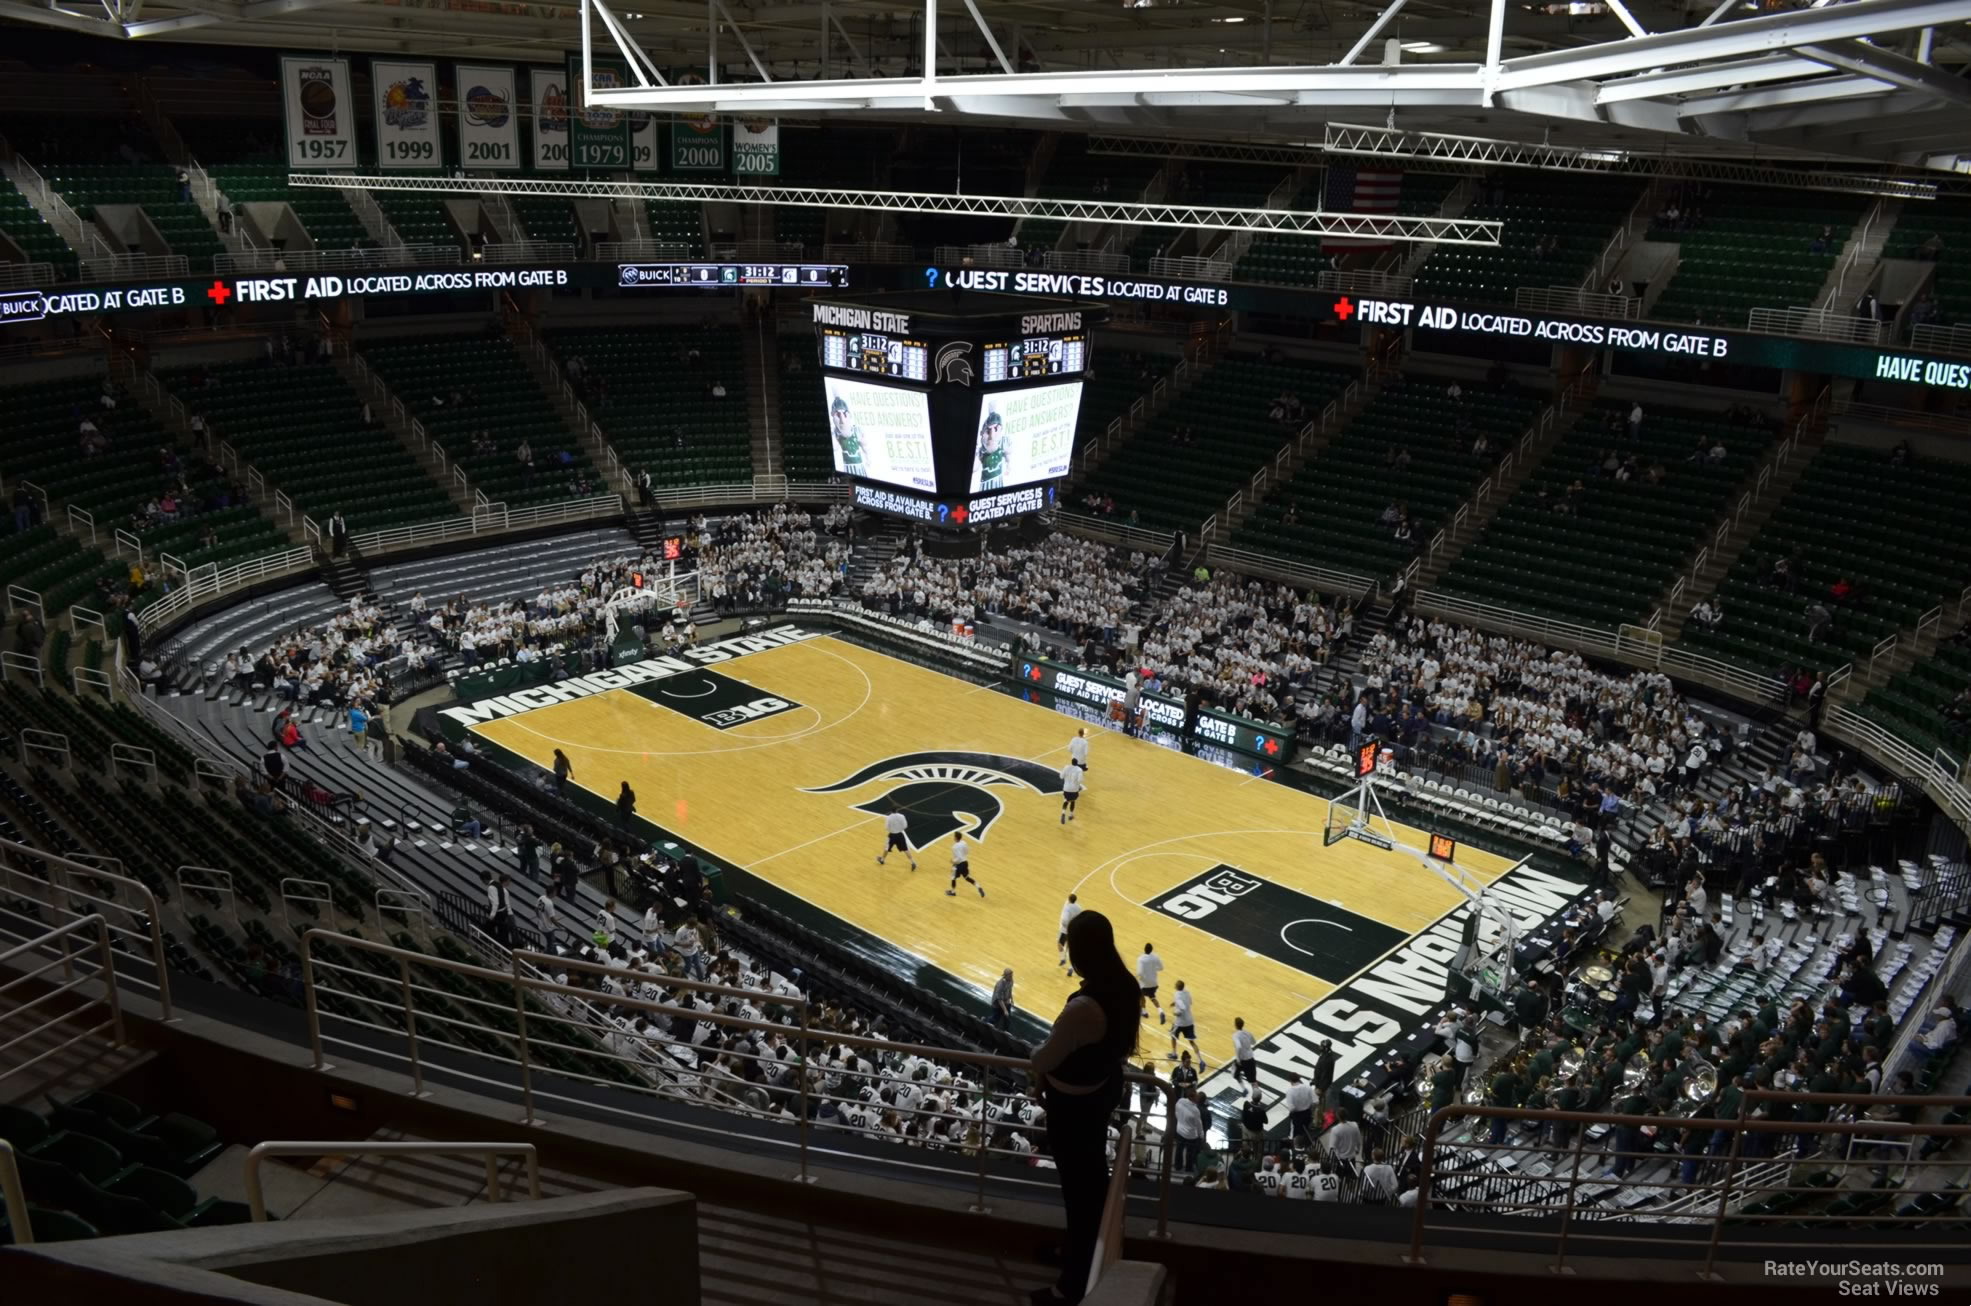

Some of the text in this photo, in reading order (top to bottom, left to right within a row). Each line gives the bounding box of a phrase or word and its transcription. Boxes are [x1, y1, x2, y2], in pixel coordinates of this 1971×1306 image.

[300, 71, 331, 81] NCAA
[577, 133, 624, 142] CHAMPIONS
[677, 136, 719, 145] CHAMPIONS
[297, 140, 348, 159] 1957
[387, 141, 433, 160] 1999
[468, 142, 511, 160] 2001
[541, 143, 569, 161] 200
[579, 145, 624, 164] 1979
[734, 142, 776, 153] WOMEN'S
[678, 147, 719, 166] 2000
[736, 154, 774, 172] 2005
[639, 271, 670, 280] BUICK
[700, 269, 708, 281] 0
[745, 267, 774, 277] 31:12
[809, 270, 818, 281] 0
[236, 270, 567, 302] FIRST AID LOCATED ACROSS FROM GATE B
[1014, 272, 1105, 296] SERVICES
[1108, 281, 1163, 299] LOCATED
[1166, 285, 1181, 300] AT
[1184, 287, 1215, 304] GATE
[1218, 290, 1228, 305] B
[3, 300, 39, 314] BUICK
[42, 287, 185, 314] CATED AT GATE B
[813, 304, 910, 335] MICHIGAN STATE
[1022, 312, 1082, 335] SPARTANS
[1357, 300, 1727, 357] FIRST AID LOCATED ACROSS FROM GATE B
[862, 335, 887, 351] 31:12
[1024, 339, 1048, 354] 31:12
[851, 357, 857, 368] 0
[892, 363, 898, 375] 0
[1052, 362, 1058, 372] 0
[1876, 355, 1923, 382] HAVE
[1012, 366, 1018, 377] 0
[849, 391, 924, 408] HAVE QUESTIONS?
[1006, 382, 1080, 416] HAVE QUESTIONS?
[853, 411, 923, 428] NEED ANSWERS?
[1005, 417, 1027, 434] NEED
[1029, 403, 1073, 429] ANSWERS?
[855, 486, 934, 512] FIRST AID IS AVAILABLE
[856, 495, 884, 509] ACROSS
[885, 500, 904, 512] FROM
[905, 504, 923, 519] GATE
[969, 486, 1043, 512] GUEST SERVICES IS
[969, 498, 1042, 523] LOCATED AT GATE B
[437, 623, 821, 727] MICHIGAN STATE
[1056, 672, 1086, 690] GUEST
[1139, 697, 1185, 720] LOCATED
[1199, 715, 1228, 735] GATE
[1228, 725, 1237, 737] B
[1055, 682, 1075, 694] FIRST
[1077, 689, 1090, 699] AID
[1092, 694, 1099, 702] IS
[1204, 728, 1226, 742] GATE
[1228, 735, 1235, 744] B
[601, 981, 613, 994] 20
[743, 974, 756, 987] 20
[645, 987, 658, 1001] 20
[740, 1008, 752, 1021] 20
[766, 1063, 779, 1078] 20
[899, 1083, 912, 1098] 20
[850, 1114, 866, 1129] 20
[1021, 1108, 1033, 1121] 20
[1258, 1175, 1276, 1189] 20
[1291, 1176, 1307, 1190] 20
[1321, 1176, 1337, 1191] 20
